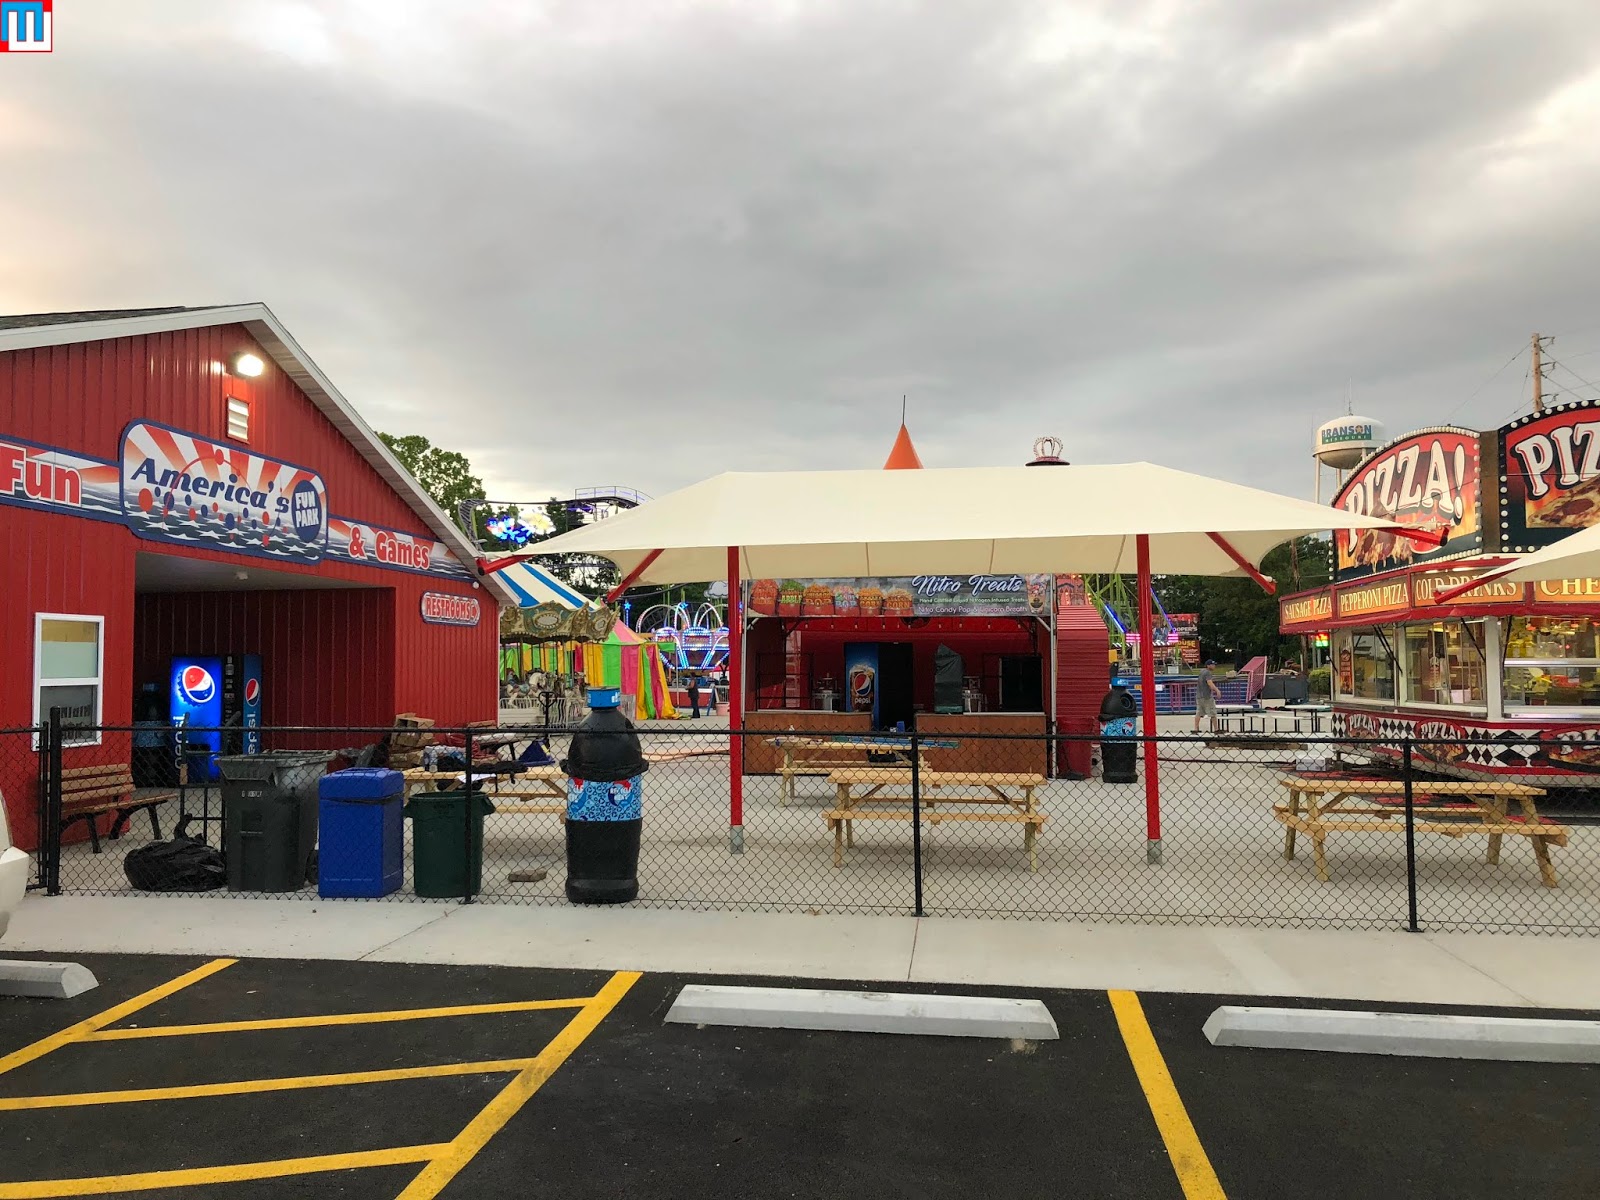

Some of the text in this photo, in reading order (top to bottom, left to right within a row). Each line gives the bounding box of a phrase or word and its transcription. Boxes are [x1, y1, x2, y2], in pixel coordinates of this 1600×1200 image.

[1321, 424, 1372, 438] BRANSON
[0, 443, 82, 507] Fun
[131, 457, 290, 514] America's
[295, 490, 316, 509] FUN
[1345, 440, 1465, 552] PIZZA!
[295, 508, 320, 528] PARK
[349, 525, 430, 570] & Games
[911, 574, 1023, 597] Nitro Treats
[1340, 582, 1409, 612] PEPPERONI PIZZA
[425, 595, 471, 620] RESTROOMS
[936, 605, 957, 614] Candy
[958, 605, 971, 614] Pop
[1284, 596, 1333, 620] SAUSAGE PIZZA
[246, 711, 258, 755] epsi
[1349, 713, 1376, 735] PIZZA!
